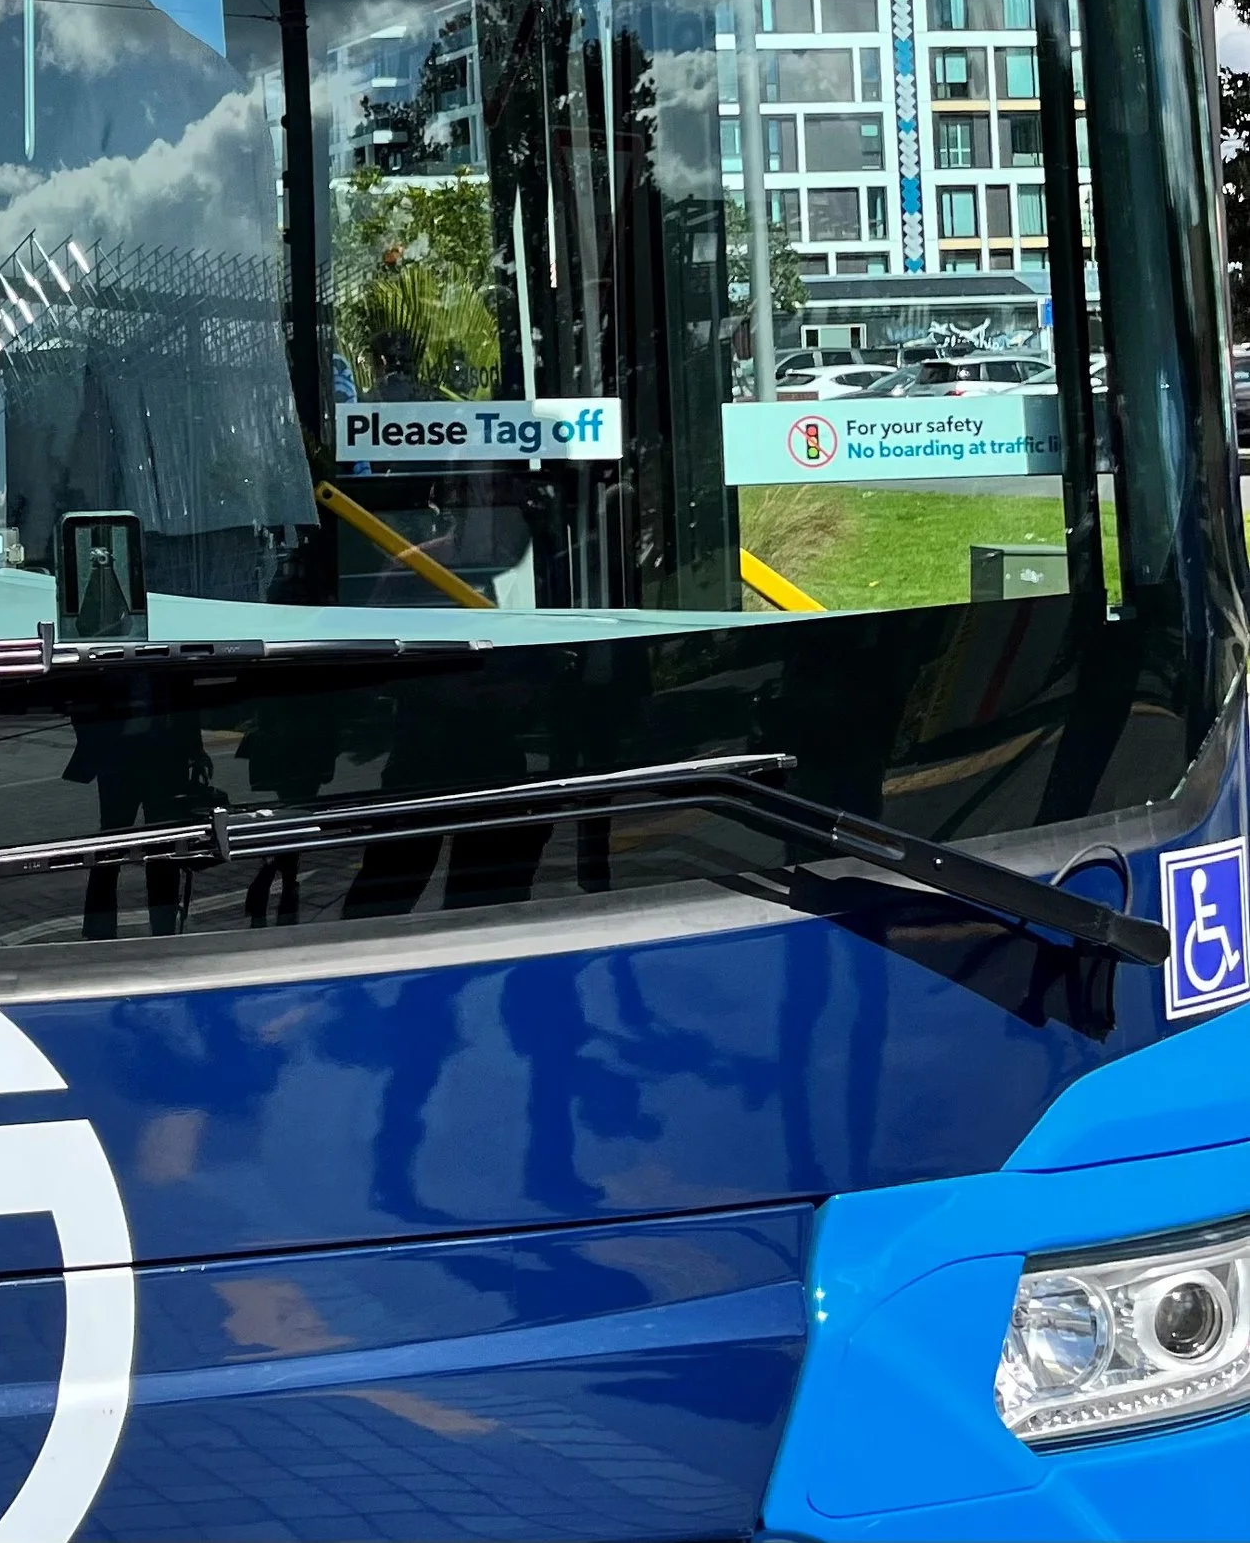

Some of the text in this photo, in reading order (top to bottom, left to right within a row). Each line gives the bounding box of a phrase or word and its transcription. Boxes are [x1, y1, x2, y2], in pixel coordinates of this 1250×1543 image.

[347, 409, 603, 453] Please Tag off
[847, 415, 983, 438] For your safety
[848, 441, 874, 458] No
[880, 437, 963, 459] boarding
[969, 438, 986, 454] at
[990, 435, 1044, 454] traffic
